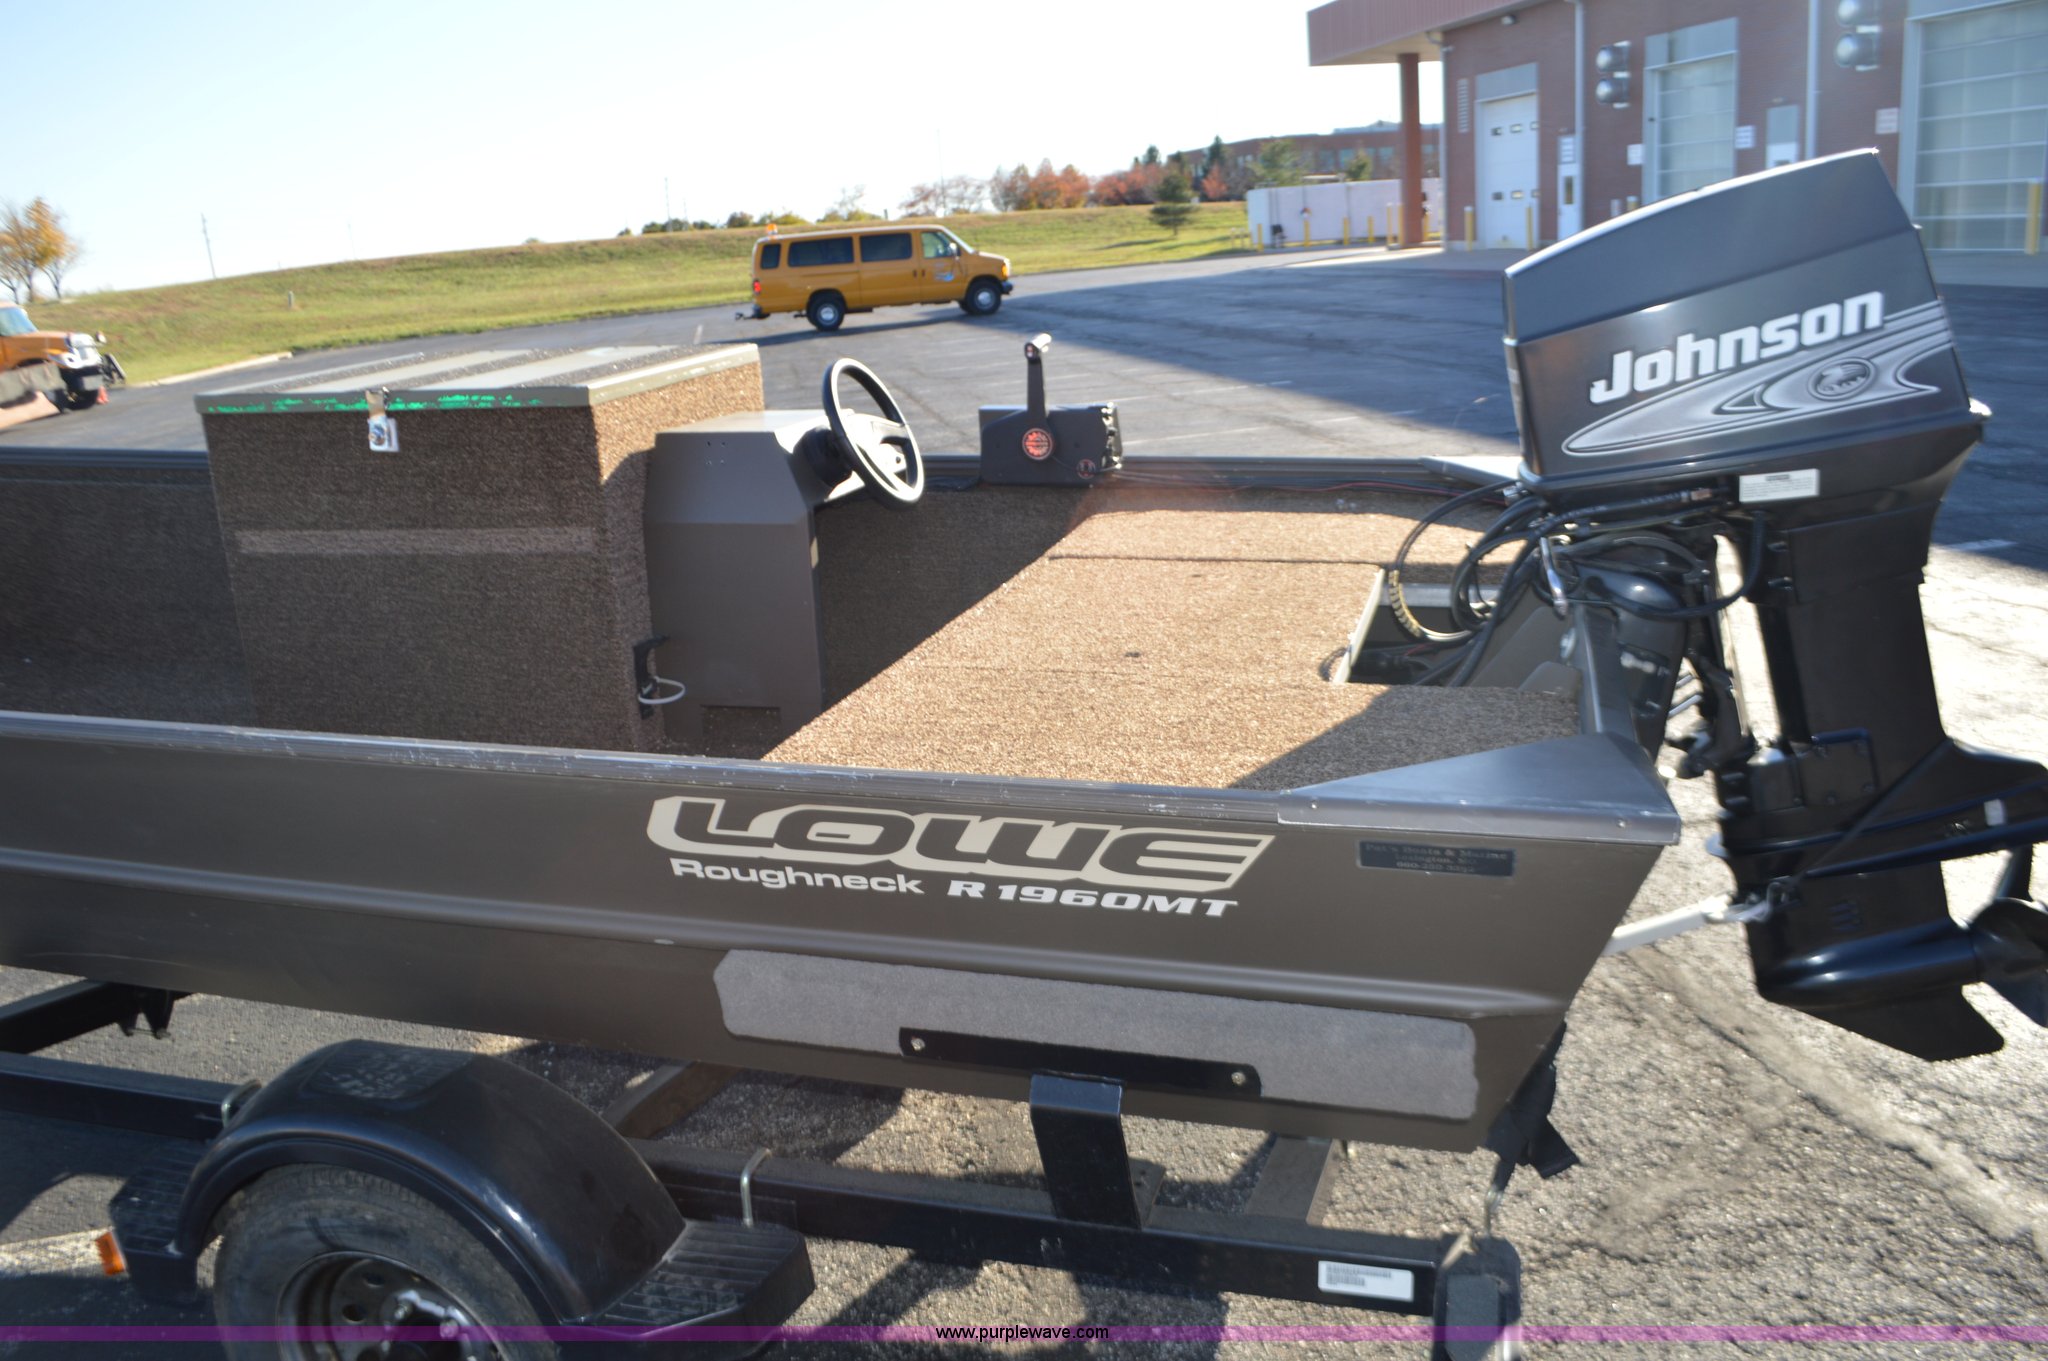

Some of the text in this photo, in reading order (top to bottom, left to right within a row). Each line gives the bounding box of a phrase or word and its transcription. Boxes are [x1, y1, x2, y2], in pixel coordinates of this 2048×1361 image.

[1590, 291, 1884, 404] Johnson
[647, 796, 1275, 892] LOWE
[670, 858, 1239, 917] Roughneck R 1960MT
